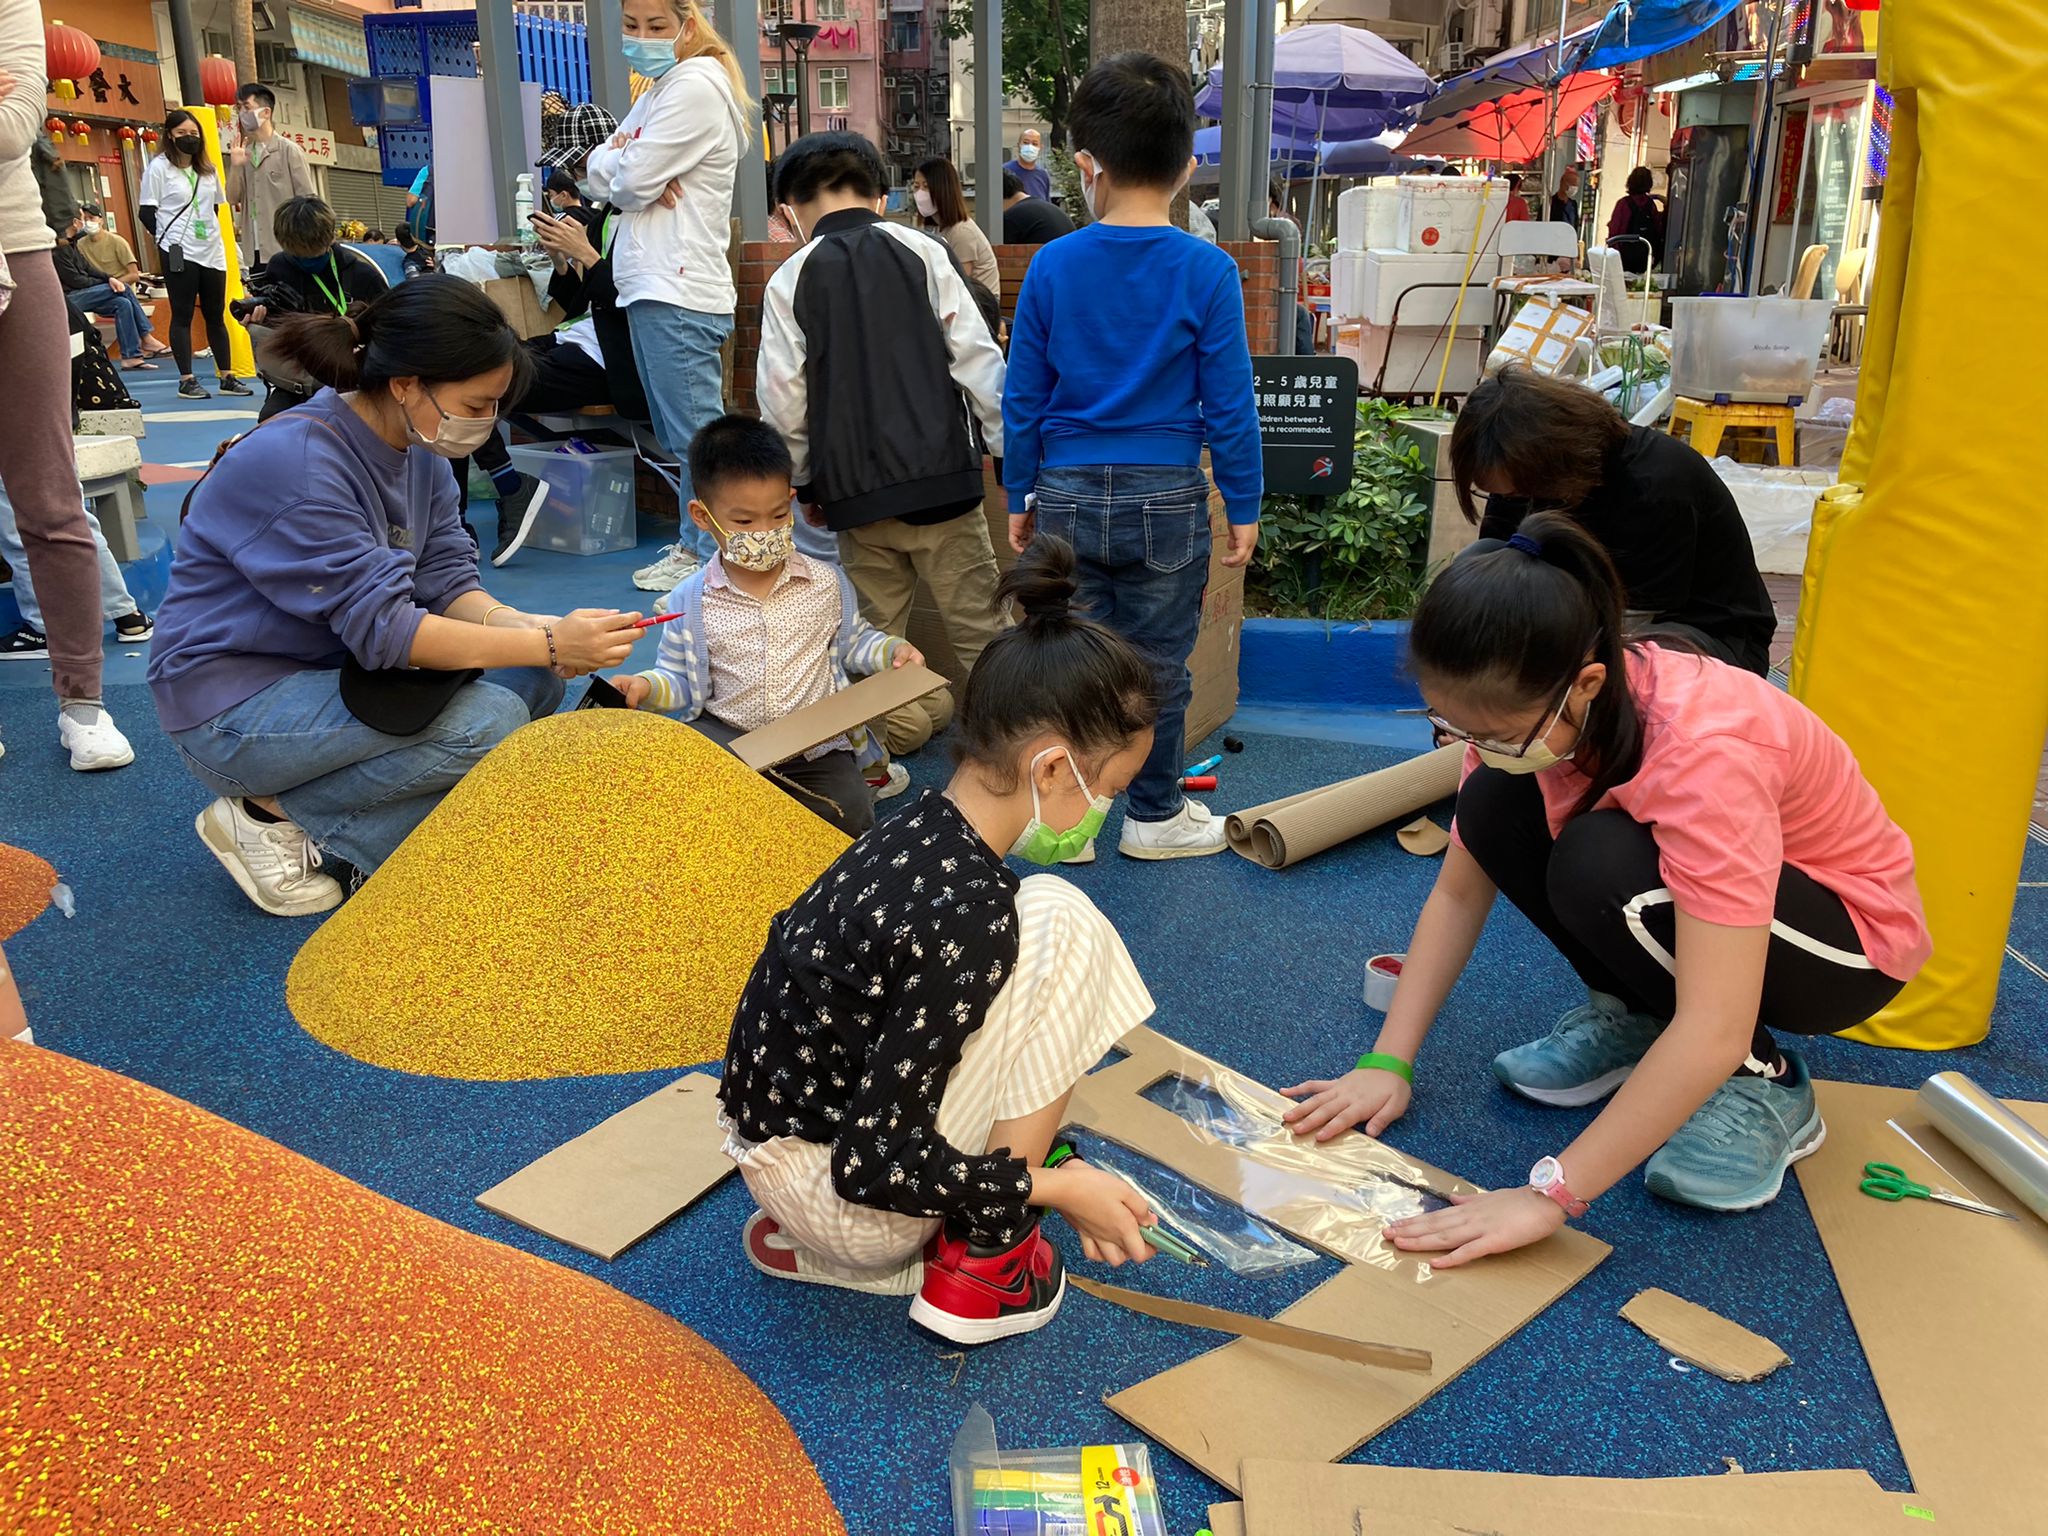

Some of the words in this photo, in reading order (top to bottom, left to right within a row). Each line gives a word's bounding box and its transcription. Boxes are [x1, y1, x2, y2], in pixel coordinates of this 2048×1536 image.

[1254, 375, 1261, 386] 2
[1280, 375, 1288, 386] 5
[1293, 375, 1338, 389] 歲兒童
[1095, 1480, 1111, 1490] 12
